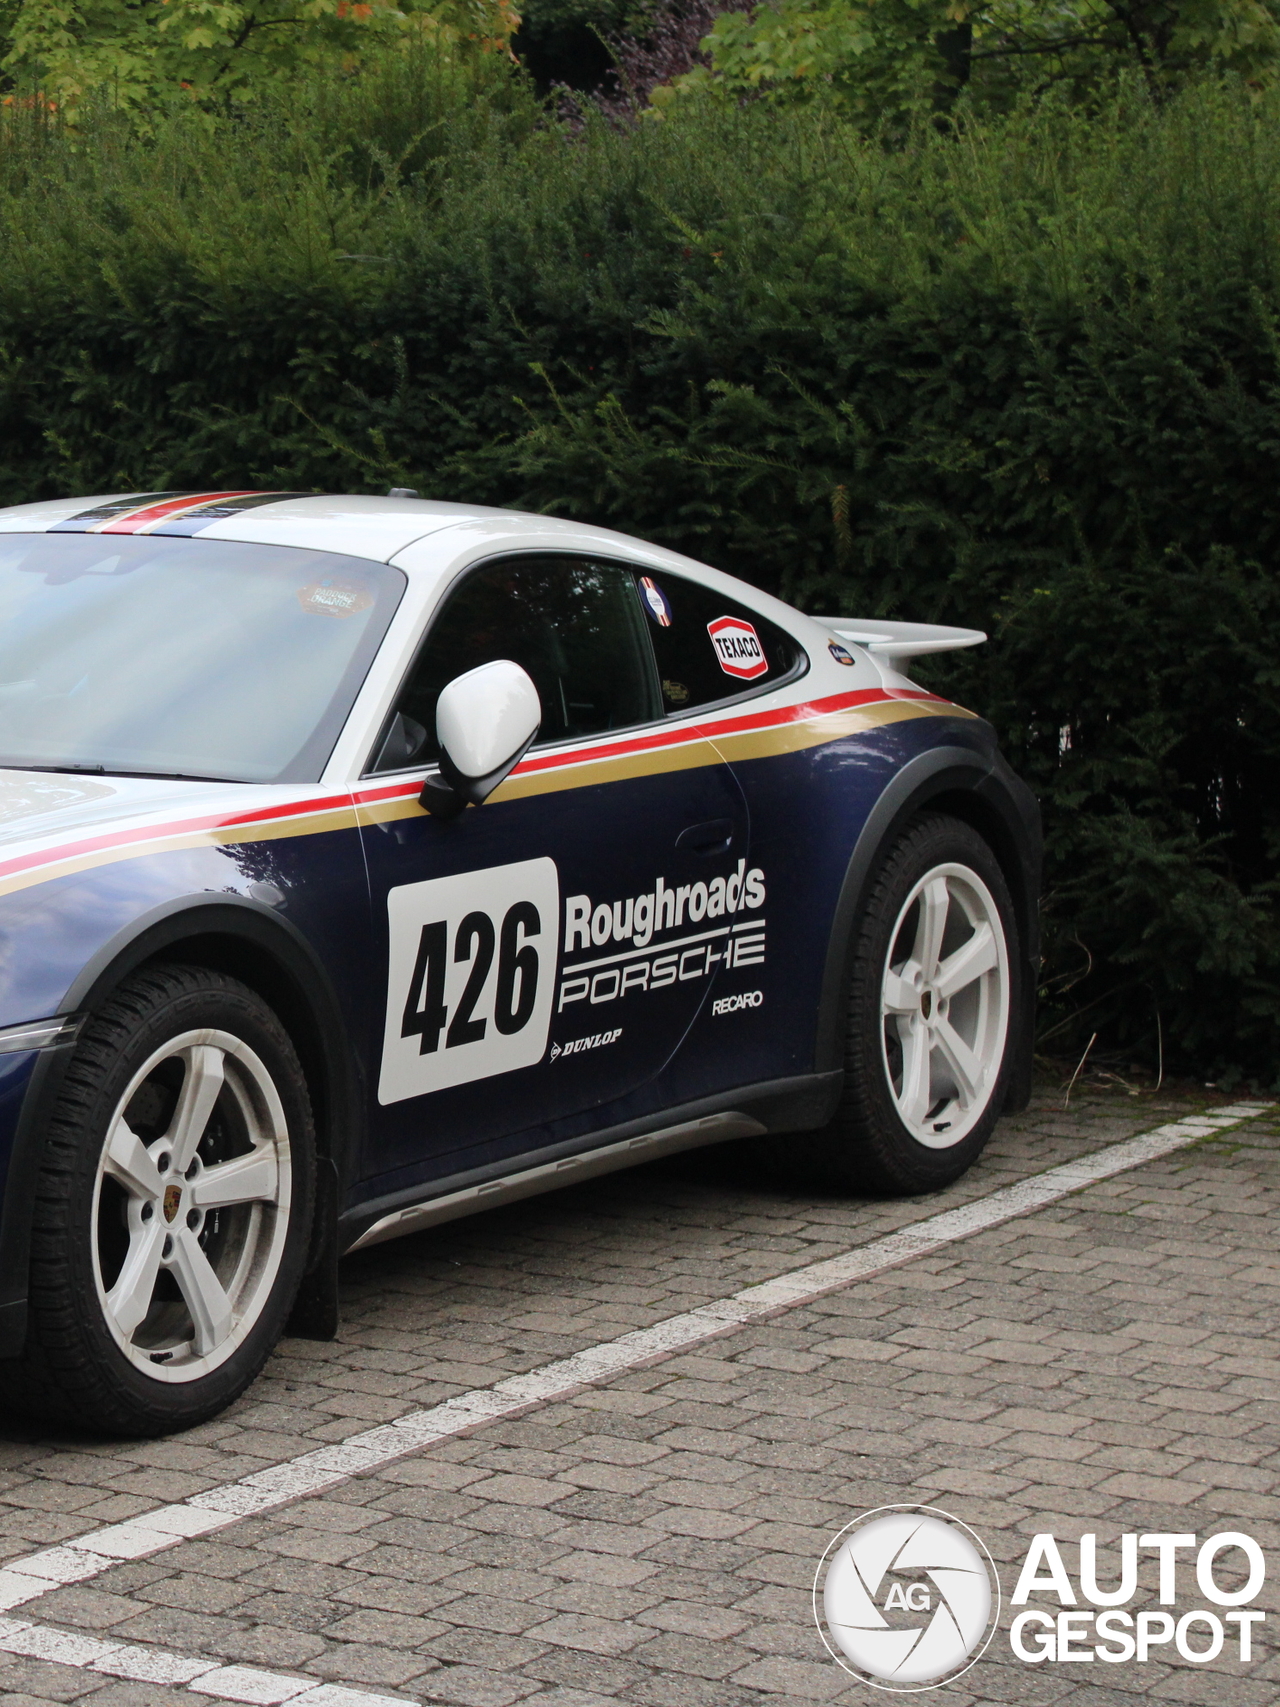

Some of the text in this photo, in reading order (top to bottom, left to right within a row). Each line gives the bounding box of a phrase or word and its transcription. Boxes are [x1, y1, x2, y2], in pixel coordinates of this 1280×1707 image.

[310, 594, 355, 609] ORANGE
[314, 588, 357, 601] PADDOCK
[715, 637, 761, 659] TEXACO
[565, 858, 766, 953] Roughroads
[400, 901, 541, 1057] 426
[558, 933, 766, 1013] PORSCHE
[712, 990, 763, 1016] RECARO
[562, 1028, 623, 1057] DUNLOP
